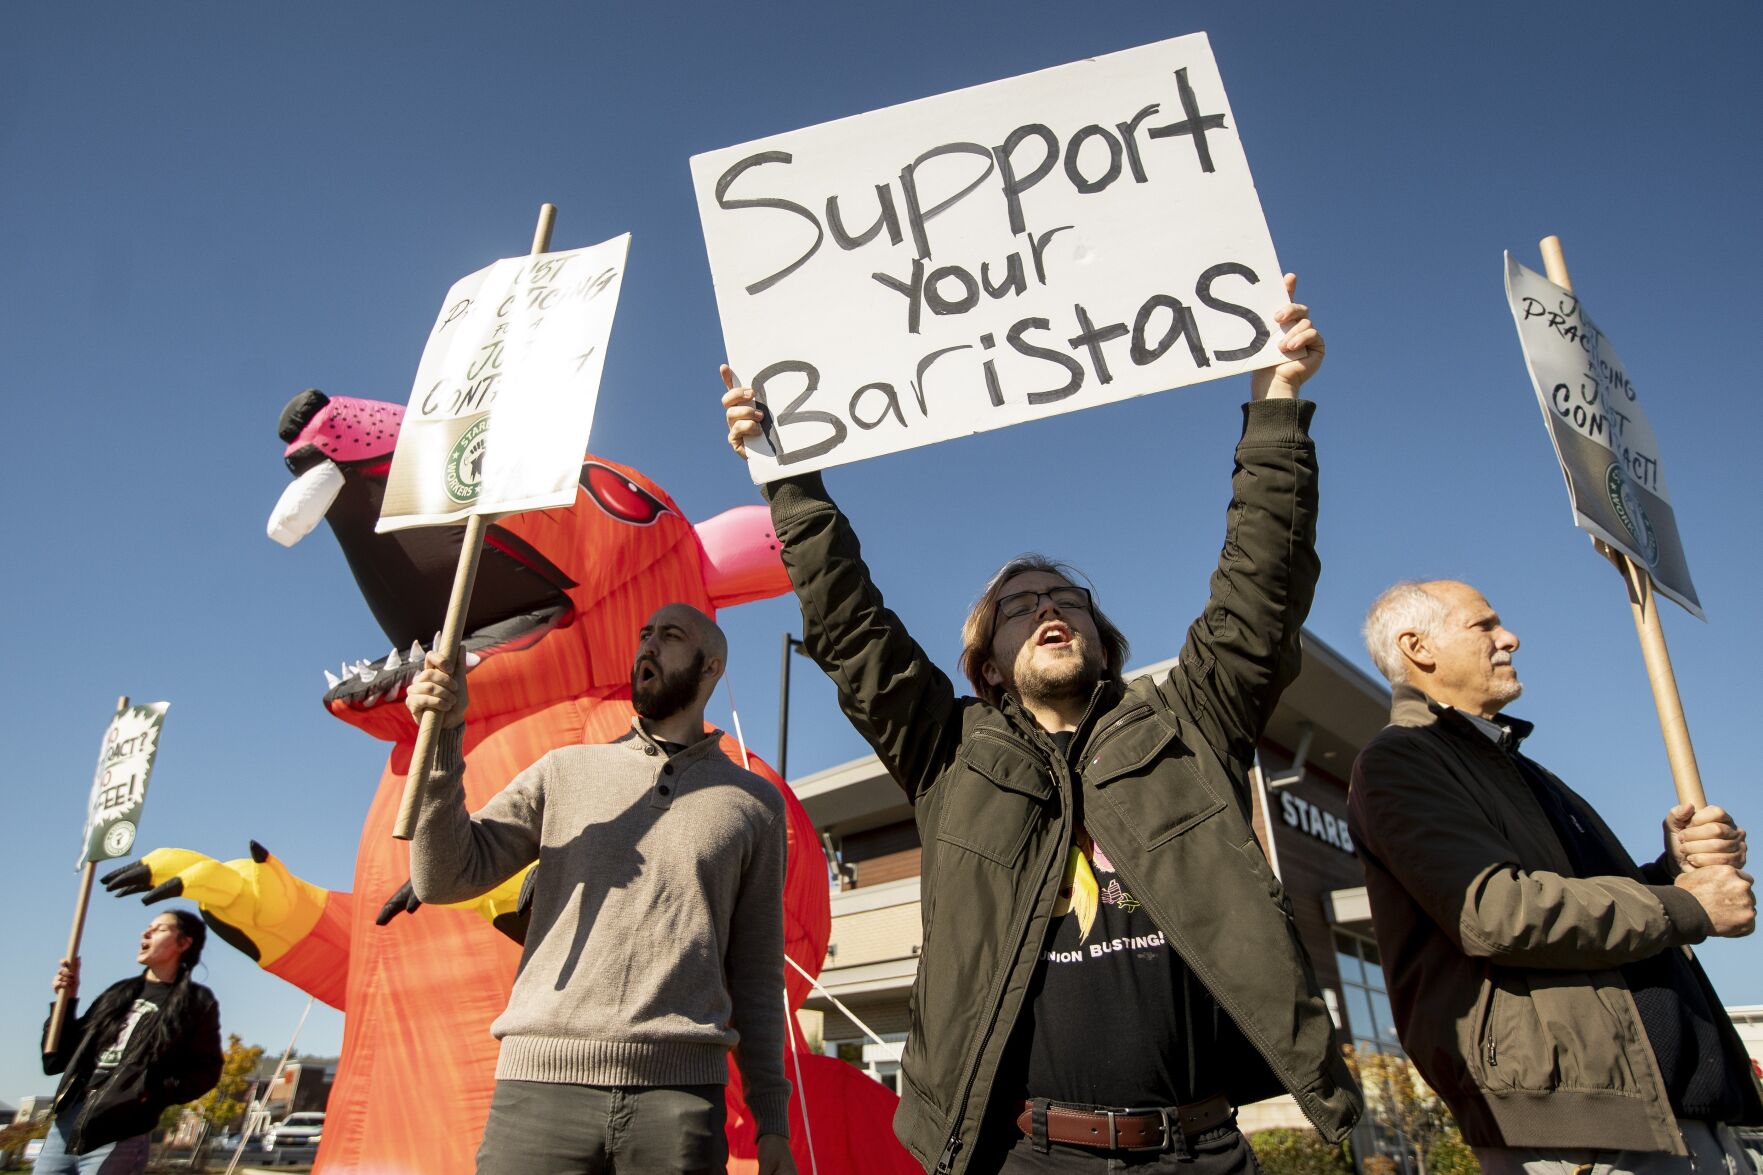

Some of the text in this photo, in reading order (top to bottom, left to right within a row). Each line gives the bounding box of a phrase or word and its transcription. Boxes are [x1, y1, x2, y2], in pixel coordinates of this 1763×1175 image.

[714, 66, 1228, 296] Support
[871, 225, 1076, 334] your
[750, 261, 1272, 466] Baristas
[447, 461, 474, 497] WORKERS
[1089, 930, 1165, 958] BUSTING!
